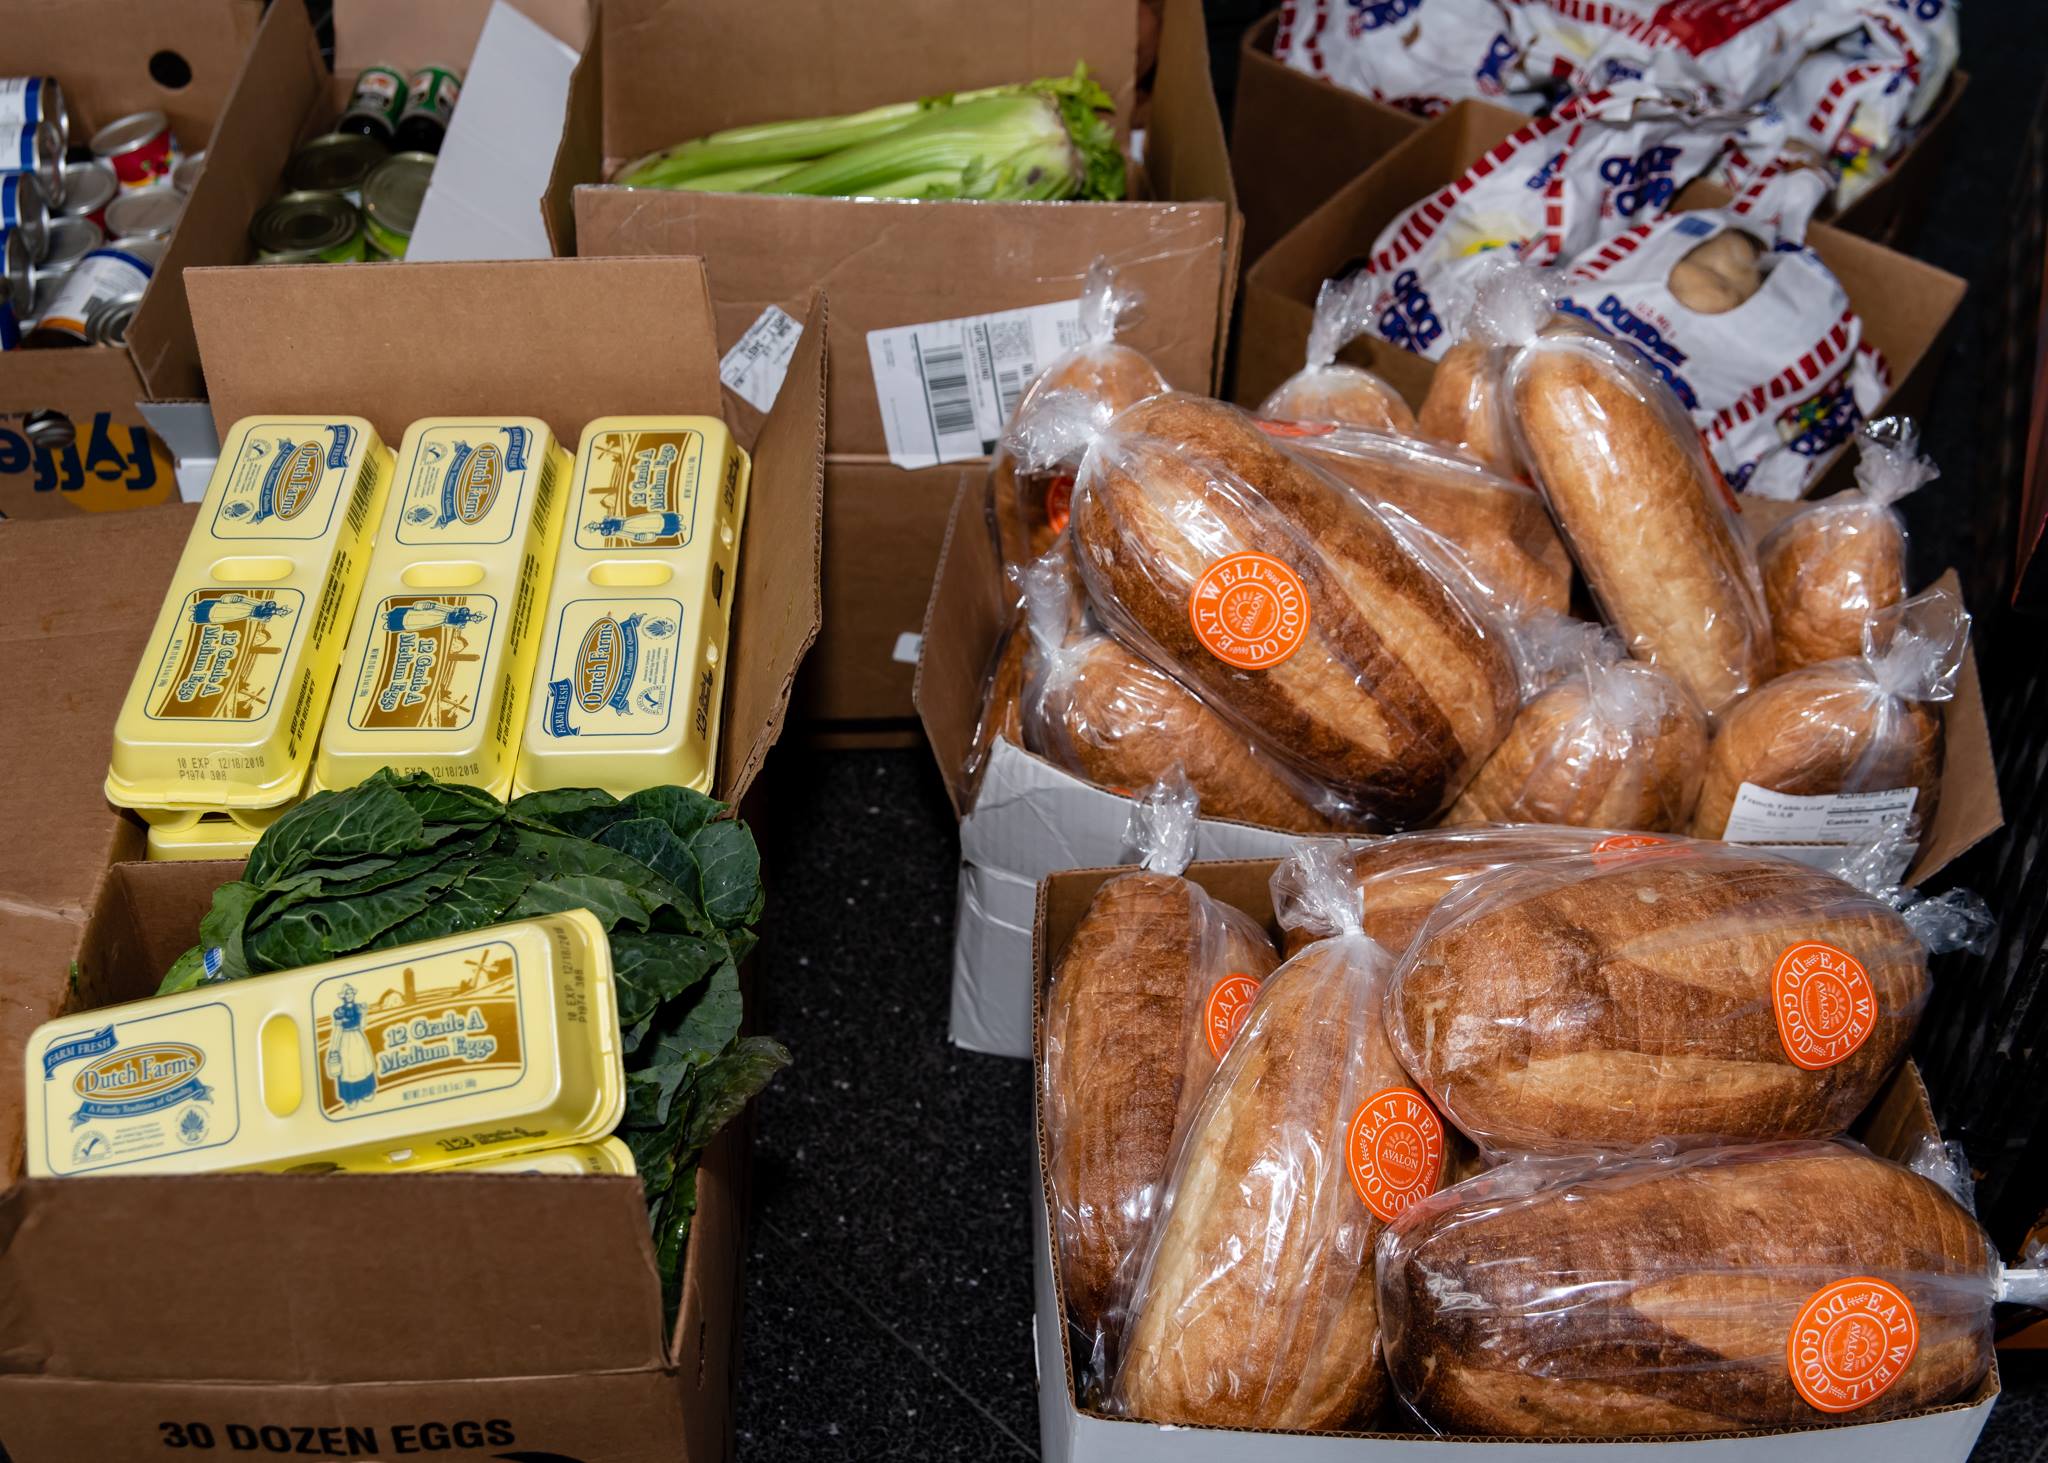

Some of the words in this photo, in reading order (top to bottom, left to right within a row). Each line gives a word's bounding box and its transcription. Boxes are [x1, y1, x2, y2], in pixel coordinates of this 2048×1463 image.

[291, 447, 319, 479] Dutch
[330, 445, 344, 465] FRESH
[472, 449, 496, 482] Dutch
[509, 447, 520, 468] FRESH
[638, 450, 653, 459] A
[654, 446, 675, 468] Eggs
[632, 461, 649, 490] Grade
[650, 470, 666, 509] Medium
[280, 482, 307, 515] Farms
[464, 485, 488, 519] Farms
[632, 493, 646, 504] 12
[1200, 562, 1265, 600] WELL
[1200, 608, 1234, 651] EAT
[1241, 592, 1265, 635] AVALON
[1250, 639, 1279, 660] DO
[1277, 581, 1299, 641] GOOD
[195, 627, 220, 671] Medium
[222, 632, 238, 645] 12
[418, 640, 434, 653] 12
[589, 623, 613, 661] Farms
[626, 626, 634, 644] Quality
[210, 648, 234, 682] Grade
[393, 634, 416, 680] Medium
[624, 652, 633, 675] Tradition
[178, 674, 206, 700] Eggs
[201, 685, 220, 696] A
[411, 657, 432, 691] Grade
[583, 665, 608, 705] Dutch
[617, 676, 630, 695] Family
[289, 716, 299, 735] KEEP
[294, 668, 311, 717] REFRIGERATED
[302, 694, 312, 720] BELOW
[382, 683, 407, 710] Eggs
[406, 692, 422, 704] A
[499, 673, 512, 723] REFRIGERATED
[505, 699, 514, 725] BELOW
[556, 684, 568, 709] FRESH
[556, 712, 567, 733] FARM
[191, 757, 209, 769] EXP
[219, 756, 265, 769] 12/18/2018
[432, 764, 480, 777] 12/18/2018
[1784, 957, 1809, 989] DO
[1819, 951, 1862, 989] EAT
[564, 984, 577, 1006] EXP
[1214, 987, 1239, 1031] EAT
[1816, 980, 1830, 1029] AVALON
[387, 1028, 408, 1047] 12
[414, 1013, 465, 1039] Grade
[467, 1010, 485, 1030] A
[1783, 993, 1813, 1053] GOOD
[1826, 997, 1870, 1057] WELL
[49, 1044, 75, 1066] FARM
[78, 1037, 111, 1057] FRESH
[379, 1044, 449, 1074] Medium
[454, 1036, 494, 1059] Eggs
[83, 1061, 137, 1092] Dutch
[142, 1055, 197, 1080] Farms
[436, 1136, 475, 1152] 12
[1359, 1100, 1397, 1143] EAT
[1407, 1100, 1439, 1166] WELL
[1382, 1149, 1418, 1169] AVALON
[1359, 1160, 1382, 1194] DO
[1382, 1183, 1427, 1213] GOOD
[1815, 1294, 1848, 1325] DO
[1865, 1292, 1907, 1335] EAT
[1801, 1329, 1830, 1393] GOOD
[1844, 1321, 1861, 1372] AVALON
[1847, 1344, 1908, 1400] WELL
[158, 1421, 216, 1450] 30
[225, 1423, 379, 1456] DOZEN
[392, 1418, 516, 1453] EGGS
